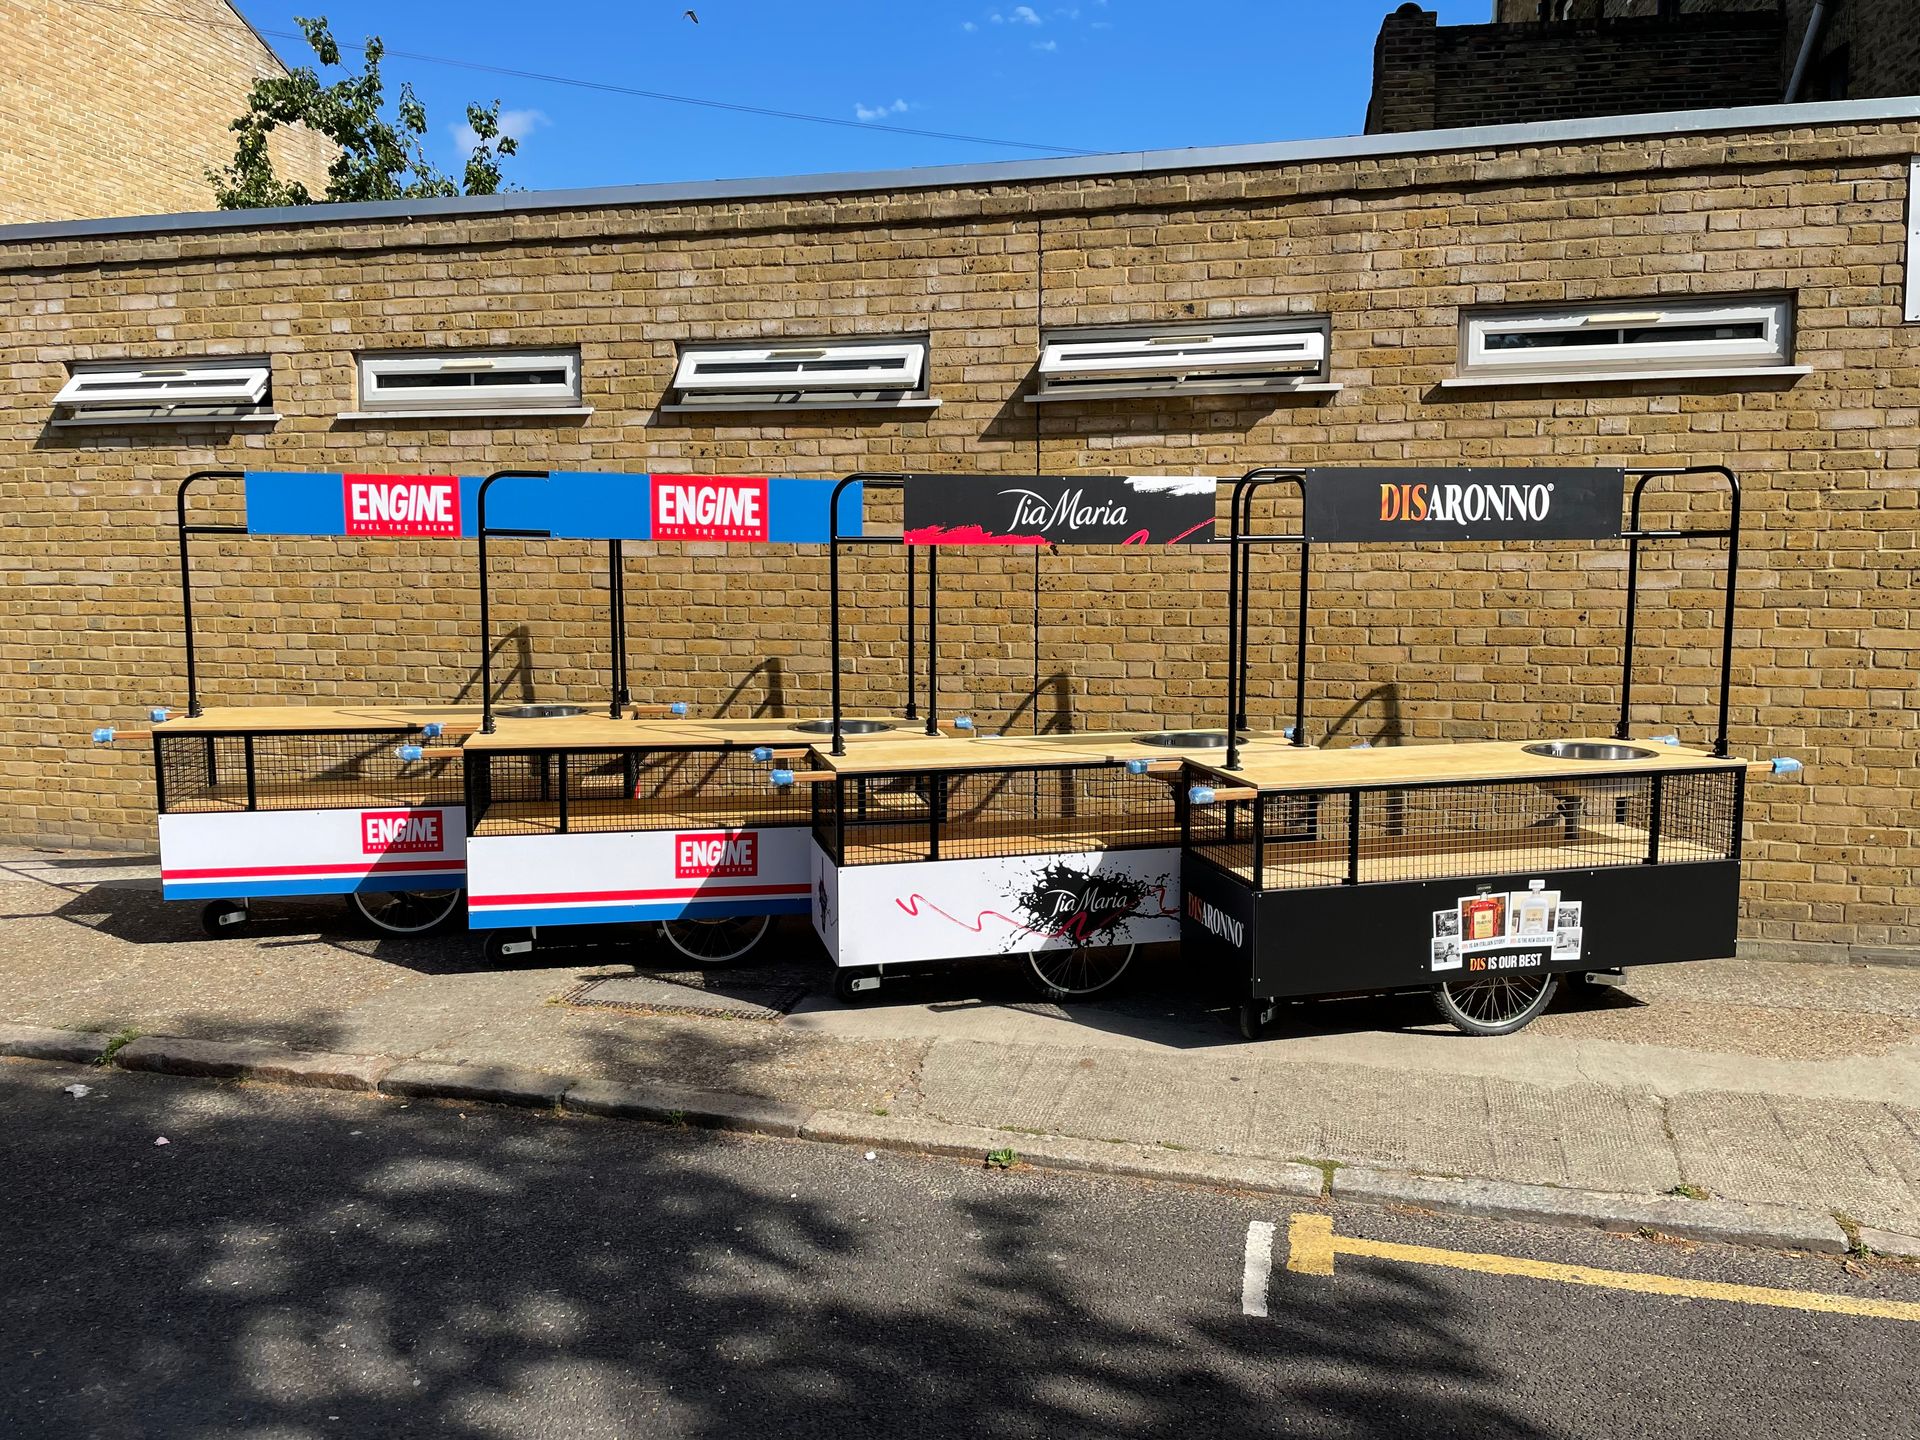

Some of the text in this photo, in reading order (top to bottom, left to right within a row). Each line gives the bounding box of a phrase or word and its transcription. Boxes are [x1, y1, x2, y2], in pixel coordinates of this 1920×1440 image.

[351, 483, 453, 522] ENGINE
[658, 485, 761, 527] ENGINE
[997, 488, 1129, 532] Tia Maria
[352, 523, 455, 532] FUEL THE DREAM
[659, 527, 761, 537] FUEL THE DREAM
[366, 817, 438, 844] ENGINE
[680, 839, 753, 867] ENGINE
[1044, 886, 1128, 918] Tia Maria
[1470, 952, 1543, 971] DIS IS OUR BEST
